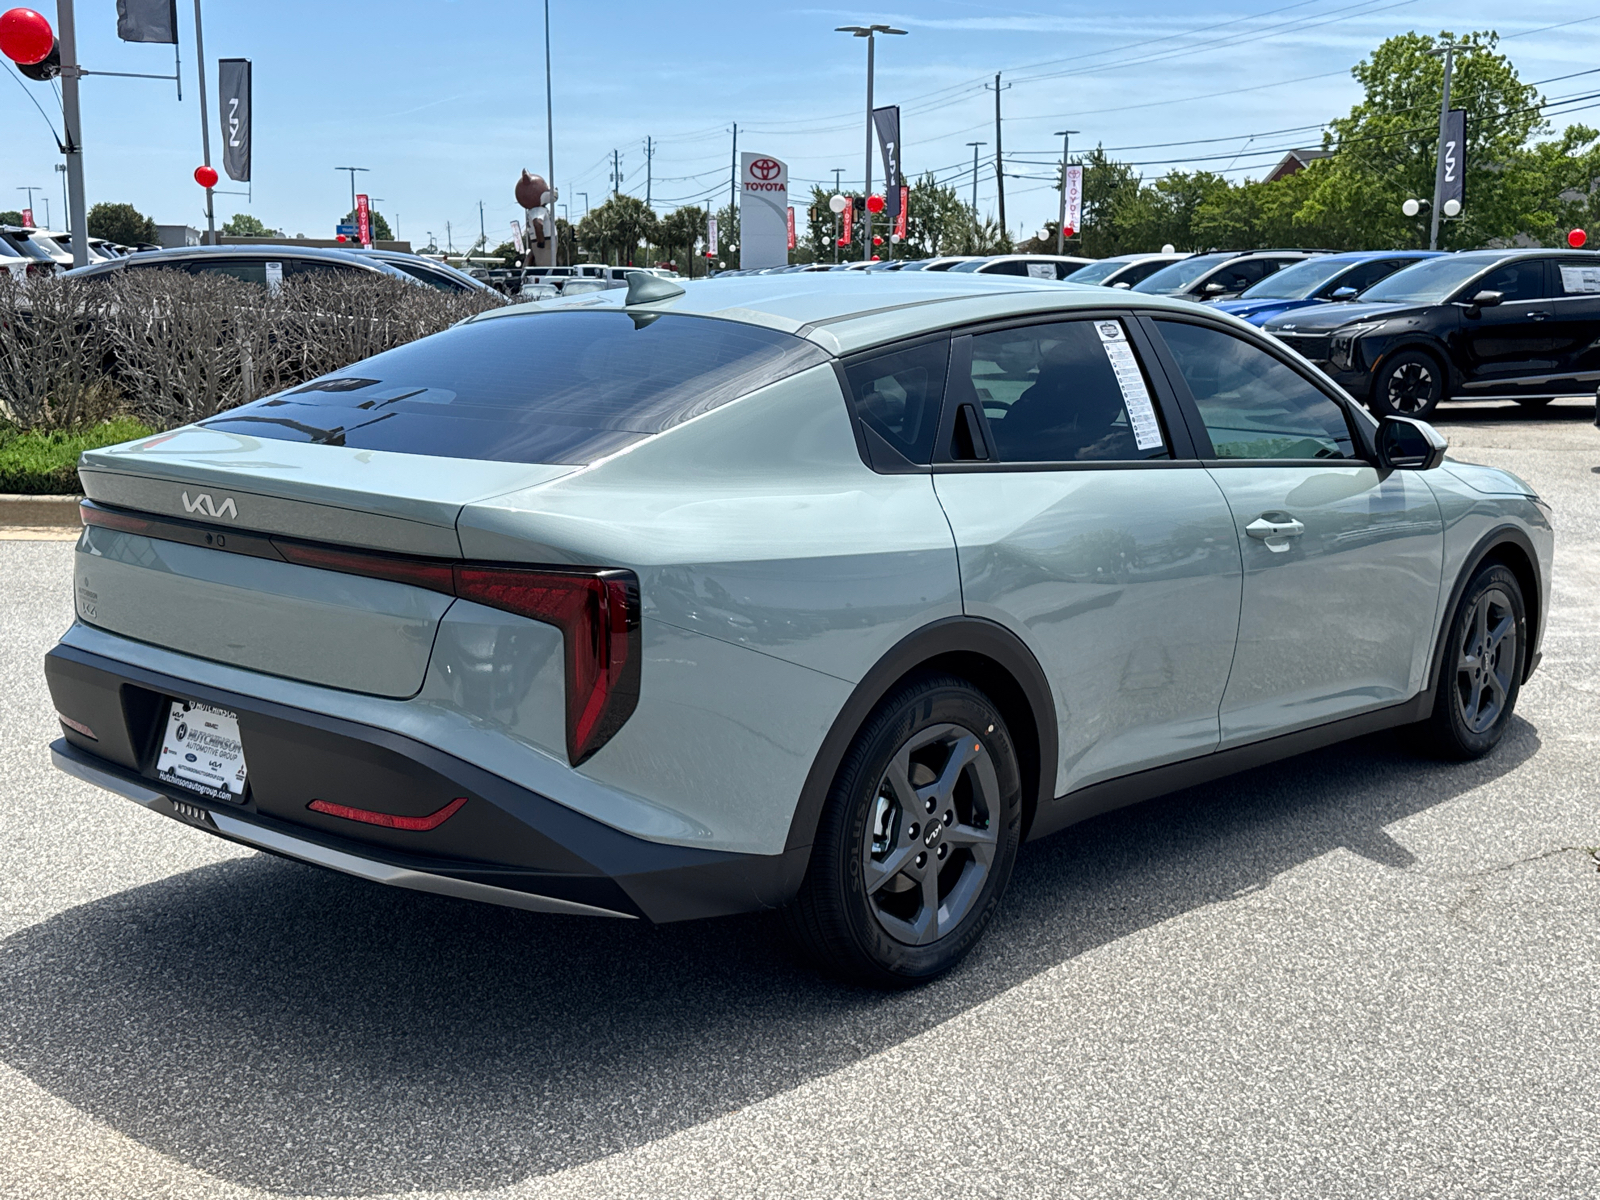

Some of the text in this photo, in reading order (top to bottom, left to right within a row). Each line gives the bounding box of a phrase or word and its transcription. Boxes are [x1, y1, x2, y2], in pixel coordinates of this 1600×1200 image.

[744, 182, 786, 192] TOYOTA
[1069, 180, 1078, 228] TOYOTA
[182, 491, 238, 519] KIA
[82, 602, 98, 619] K4
[204, 721, 219, 730] GMC
[187, 728, 242, 754] HUTCHINSON
[186, 742, 238, 762] AUTOMOTIVE GROUP
[208, 760, 222, 769] KIA
[850, 802, 866, 893] SOLUS
